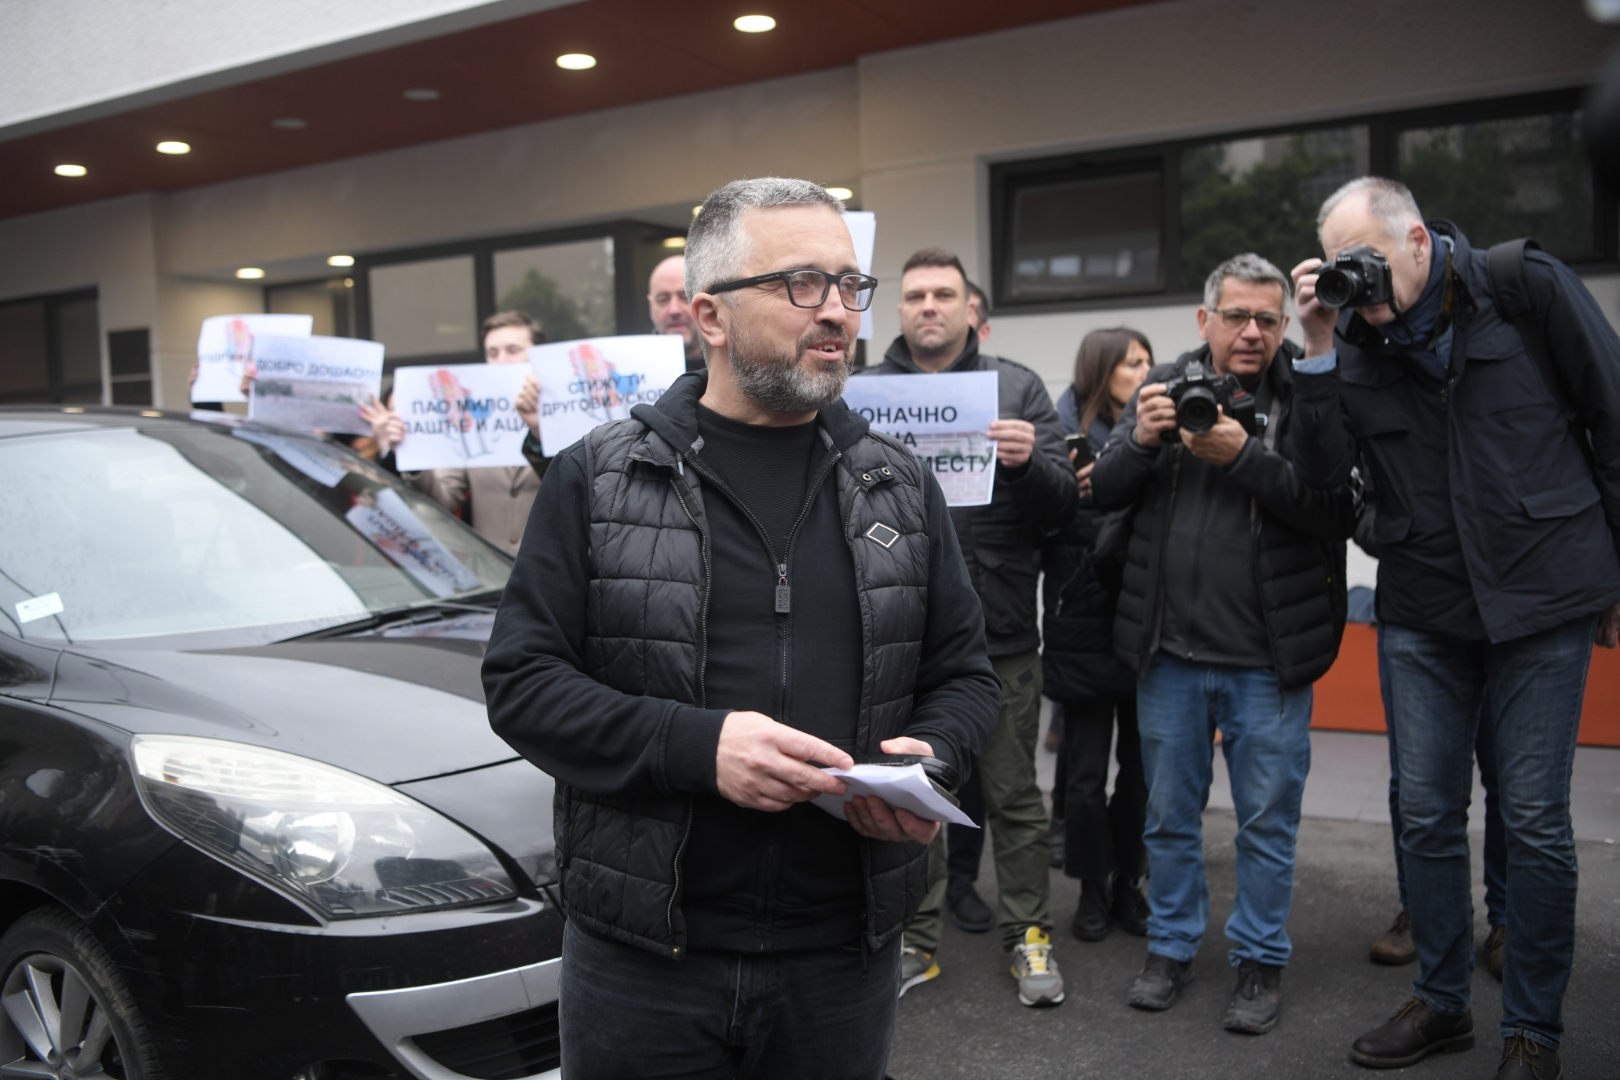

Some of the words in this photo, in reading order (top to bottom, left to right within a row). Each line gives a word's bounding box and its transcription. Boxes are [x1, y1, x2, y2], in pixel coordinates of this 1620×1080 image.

[256, 357, 305, 375] ДОБРО
[412, 399, 451, 415] ПАО
[850, 405, 958, 423] ОНАЧНО
[477, 419, 488, 433] И
